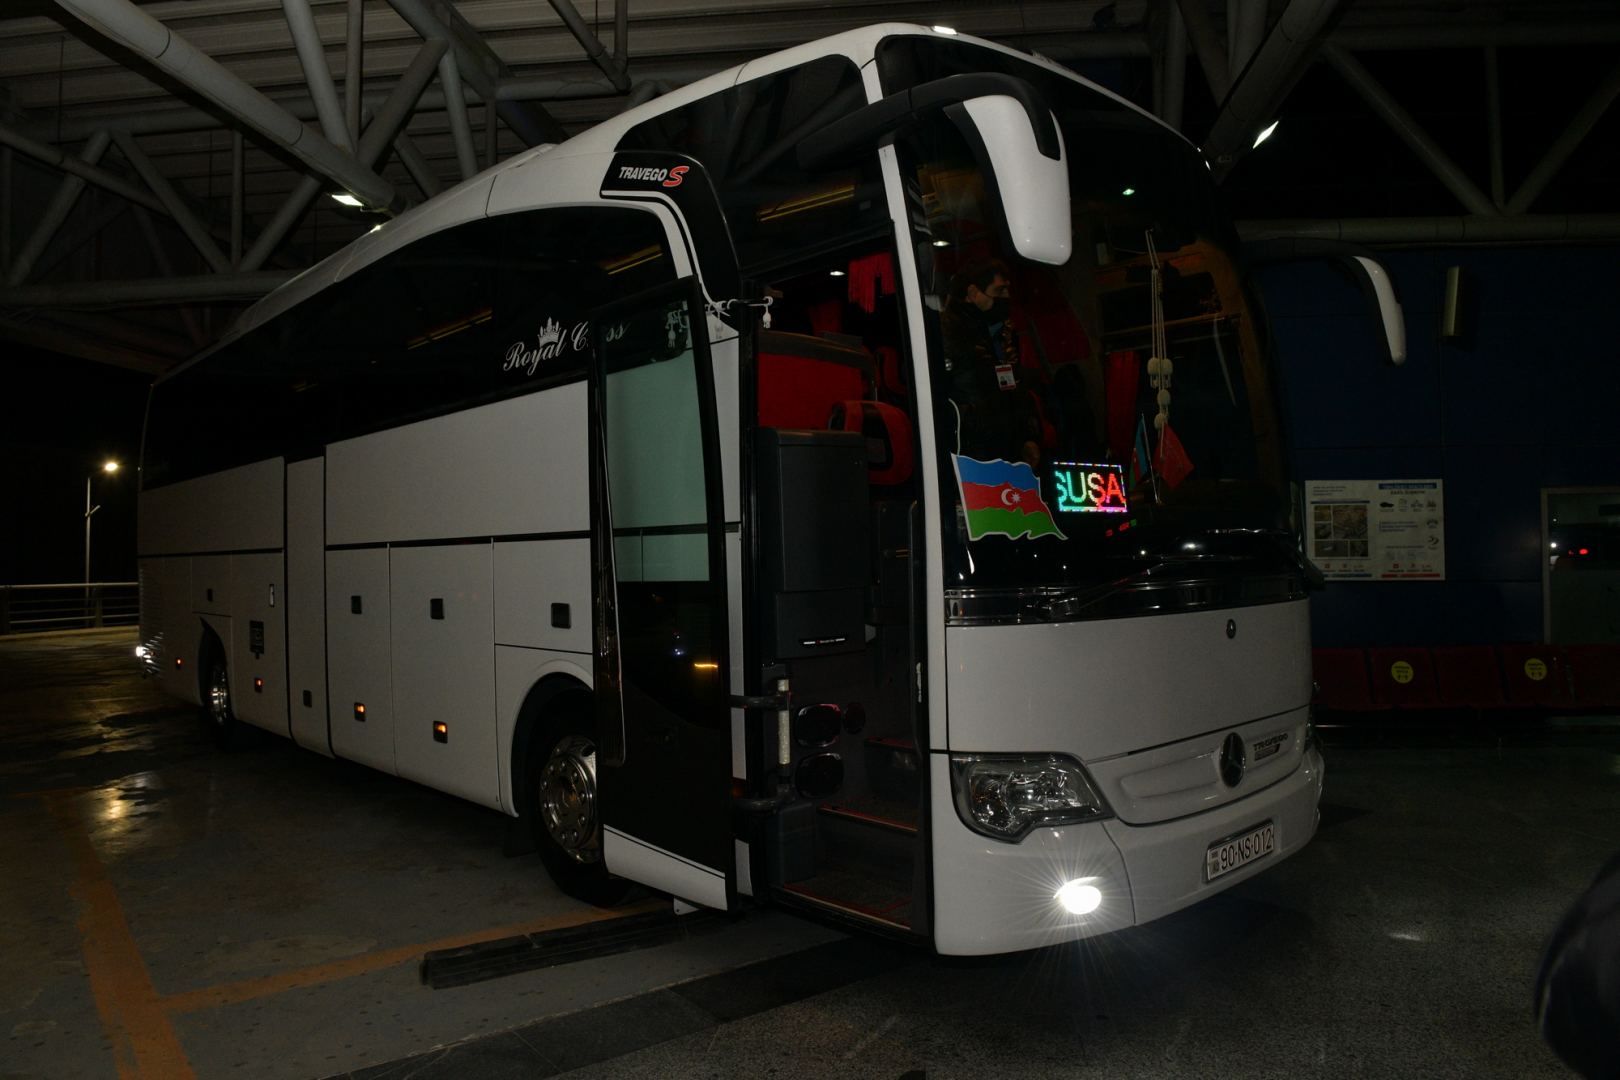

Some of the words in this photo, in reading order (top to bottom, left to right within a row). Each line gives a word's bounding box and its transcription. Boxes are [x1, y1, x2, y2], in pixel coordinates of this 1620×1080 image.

[618, 166, 668, 182] TRAVEGO
[502, 328, 567, 376] Royal
[570, 320, 628, 352] Css
